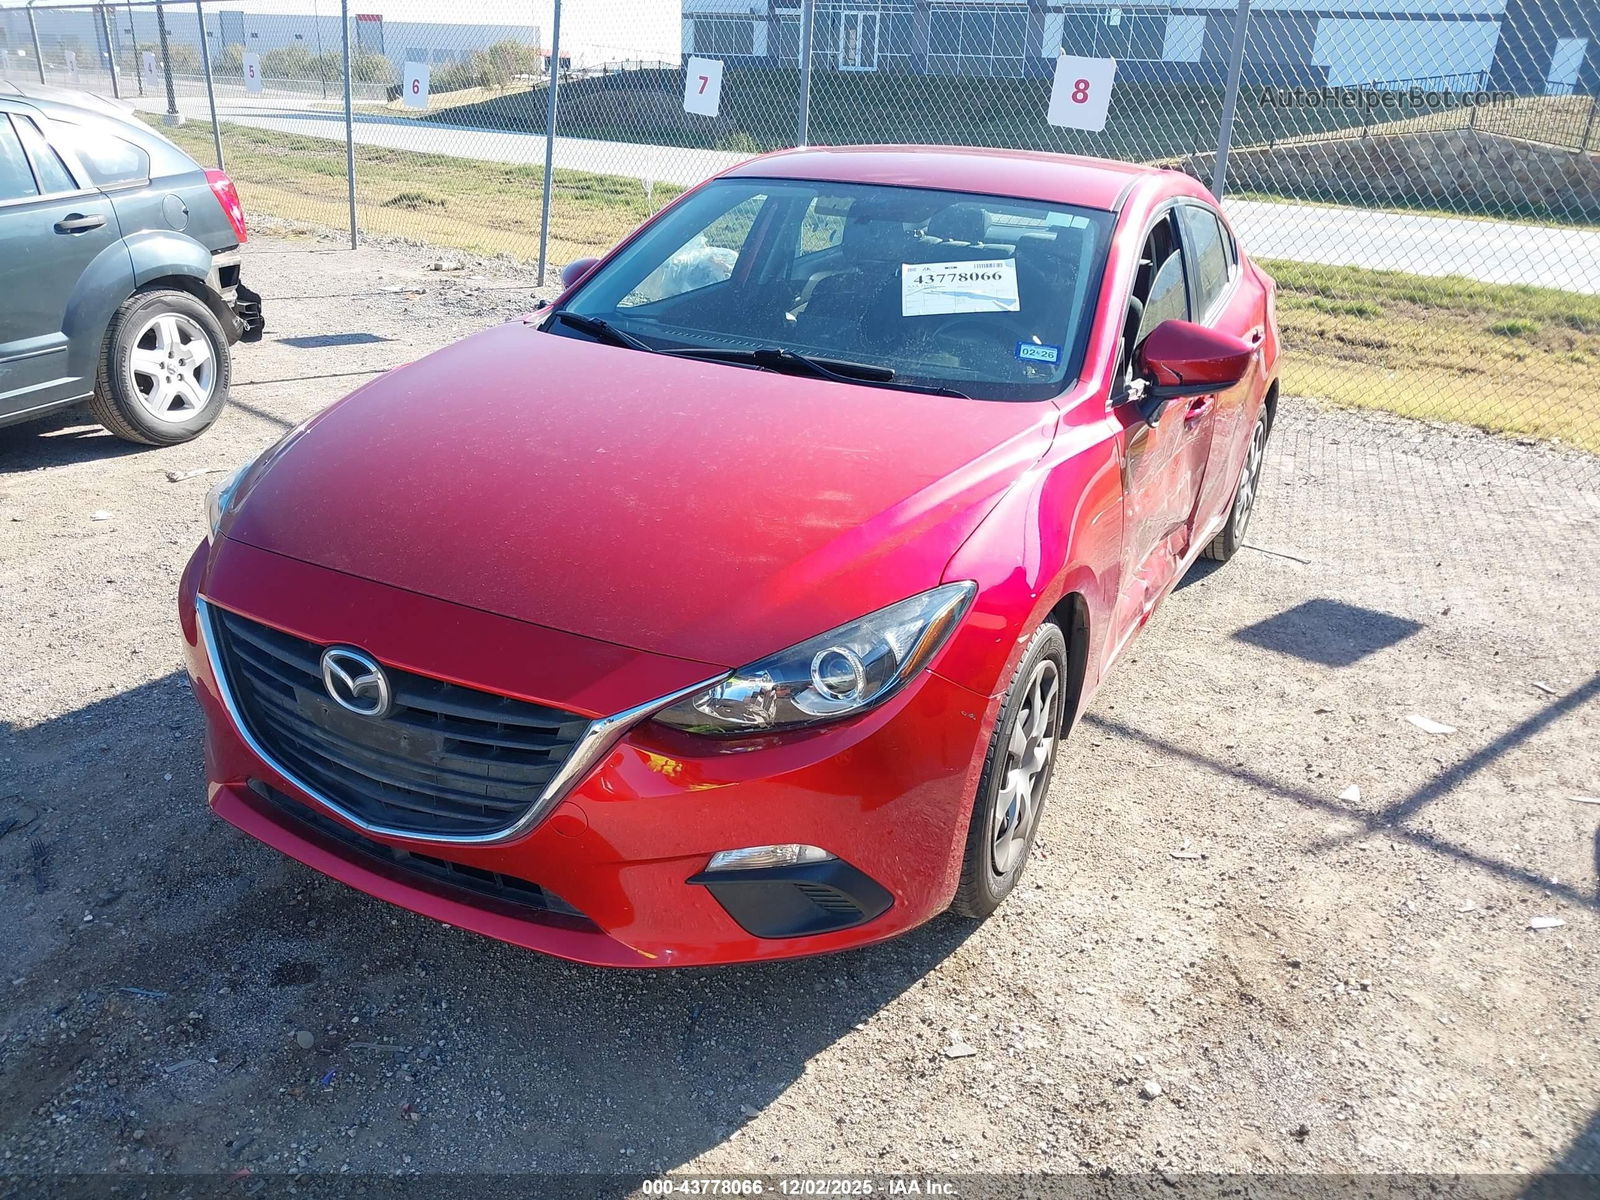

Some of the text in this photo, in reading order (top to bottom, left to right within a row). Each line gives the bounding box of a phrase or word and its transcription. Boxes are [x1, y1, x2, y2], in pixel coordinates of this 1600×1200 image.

[249, 65, 255, 78] 5
[412, 79, 420, 94] 6
[698, 75, 709, 95] 7
[1071, 78, 1090, 104] 8
[913, 271, 1002, 284] 43778066
